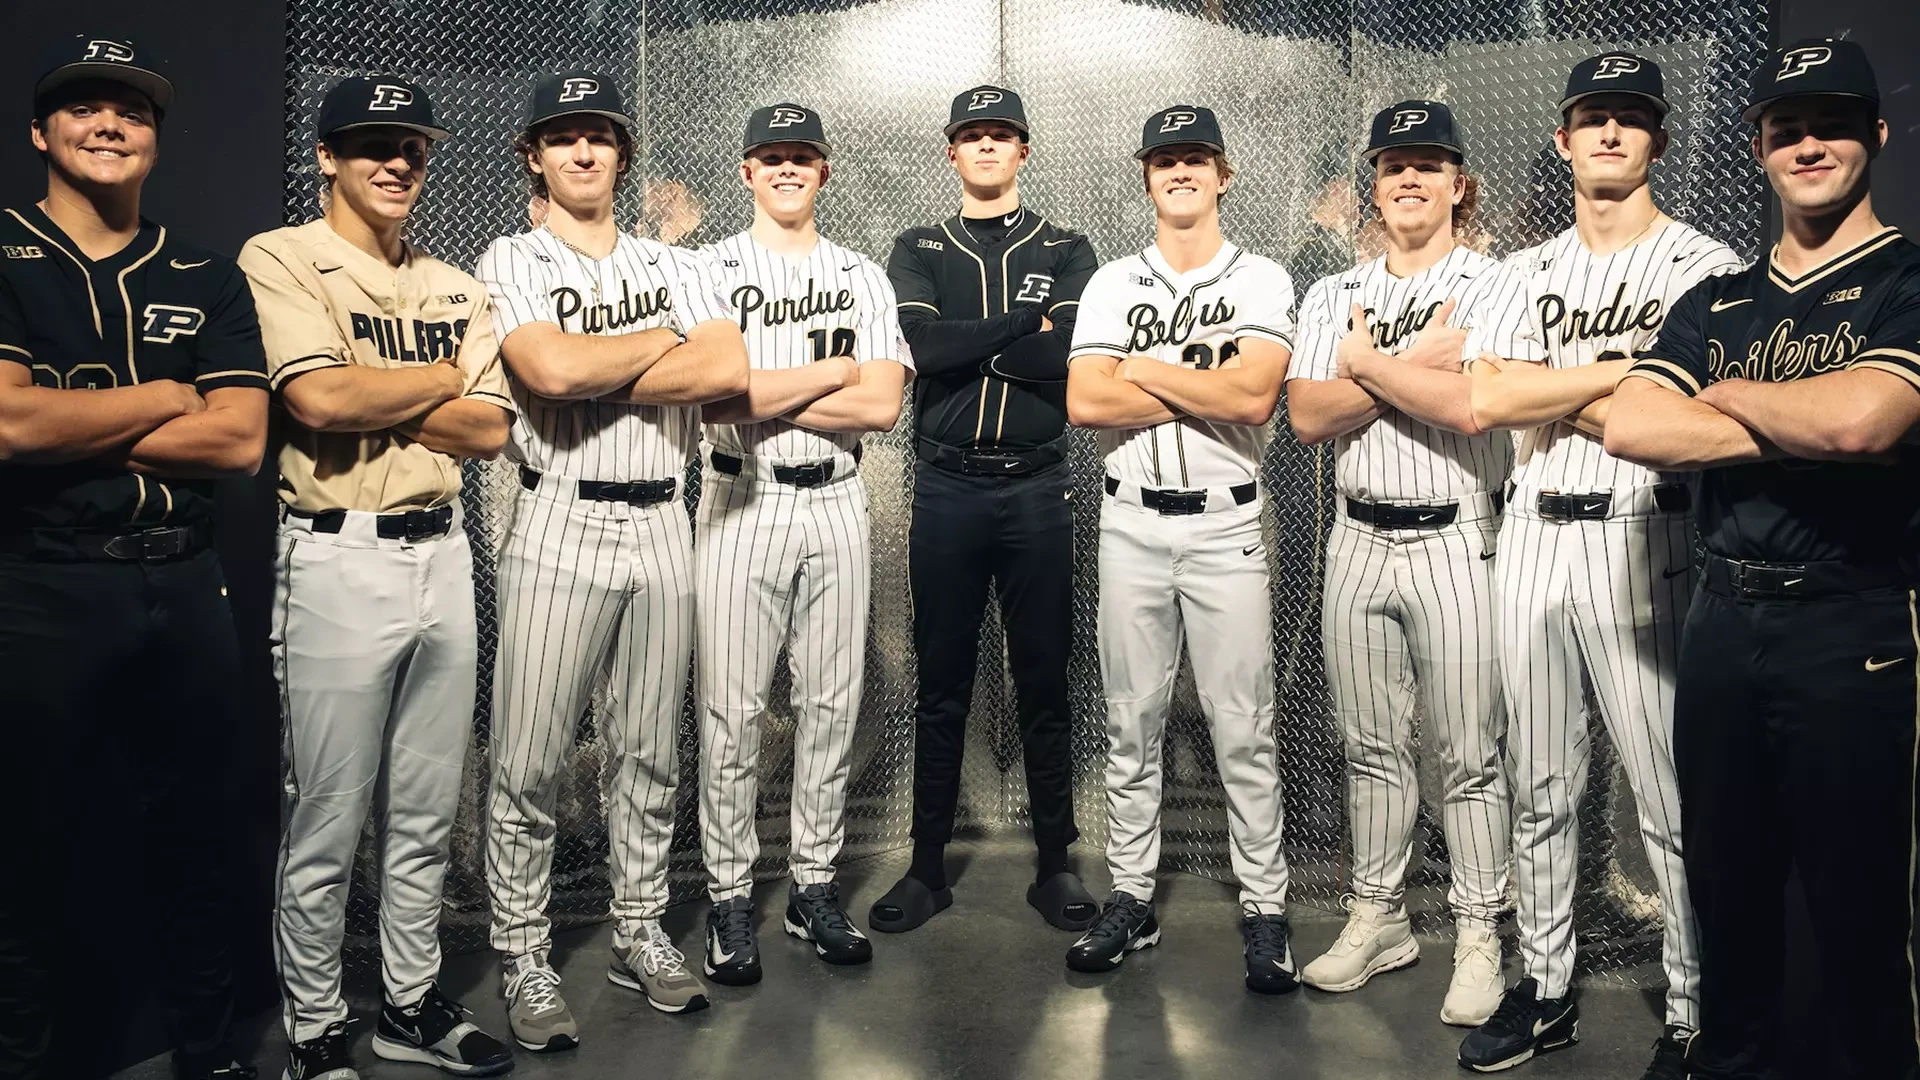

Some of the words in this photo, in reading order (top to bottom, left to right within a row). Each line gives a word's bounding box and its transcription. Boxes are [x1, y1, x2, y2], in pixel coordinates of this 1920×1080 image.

[83, 40, 134, 62] P
[1592, 56, 1640, 80] P
[1775, 47, 1832, 82] P
[368, 84, 414, 111] P
[558, 78, 600, 103] P
[967, 90, 1003, 112] P
[768, 107, 806, 128] P
[1159, 111, 1197, 133] P
[1388, 109, 1429, 135] P
[550, 279, 672, 334] Purdue
[731, 278, 855, 334] Purdue
[143, 304, 206, 344] P
